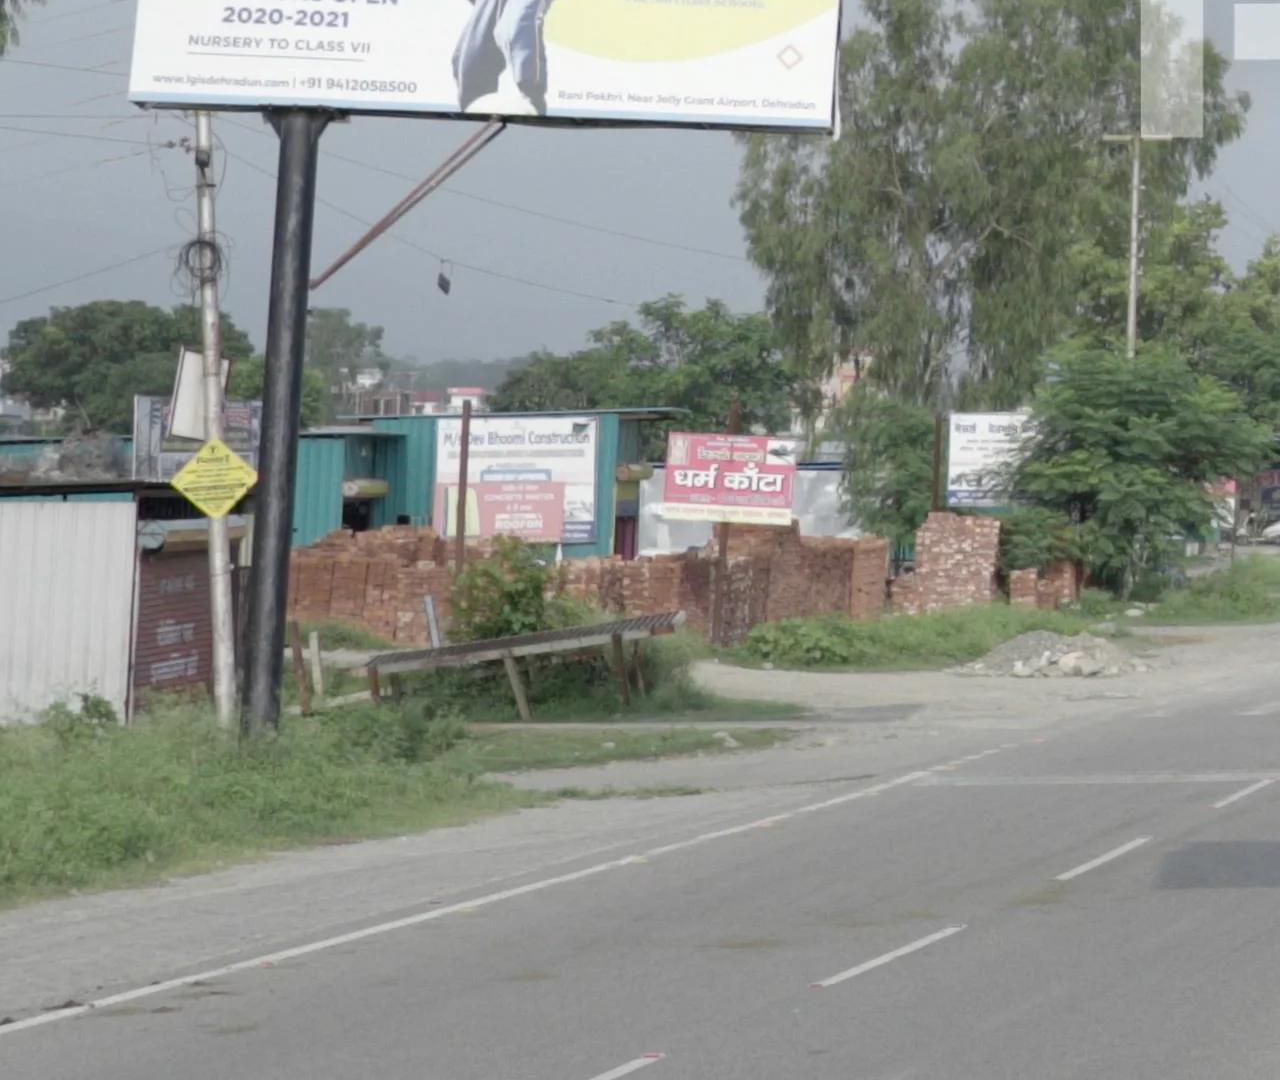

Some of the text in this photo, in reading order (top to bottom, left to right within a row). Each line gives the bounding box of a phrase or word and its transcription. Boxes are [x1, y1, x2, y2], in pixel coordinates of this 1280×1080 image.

[221, 7, 350, 29] 2020-2021
[188, 35, 371, 54] NURSERY TO CLASS VII
[299, 77, 322, 90] +91
[656, 94, 682, 107] Jolly
[762, 98, 816, 110] Dehradun
[488, 431, 525, 446] Bhoomi
[528, 431, 590, 446] Construction
[673, 461, 785, 493] धर्म काँटा
